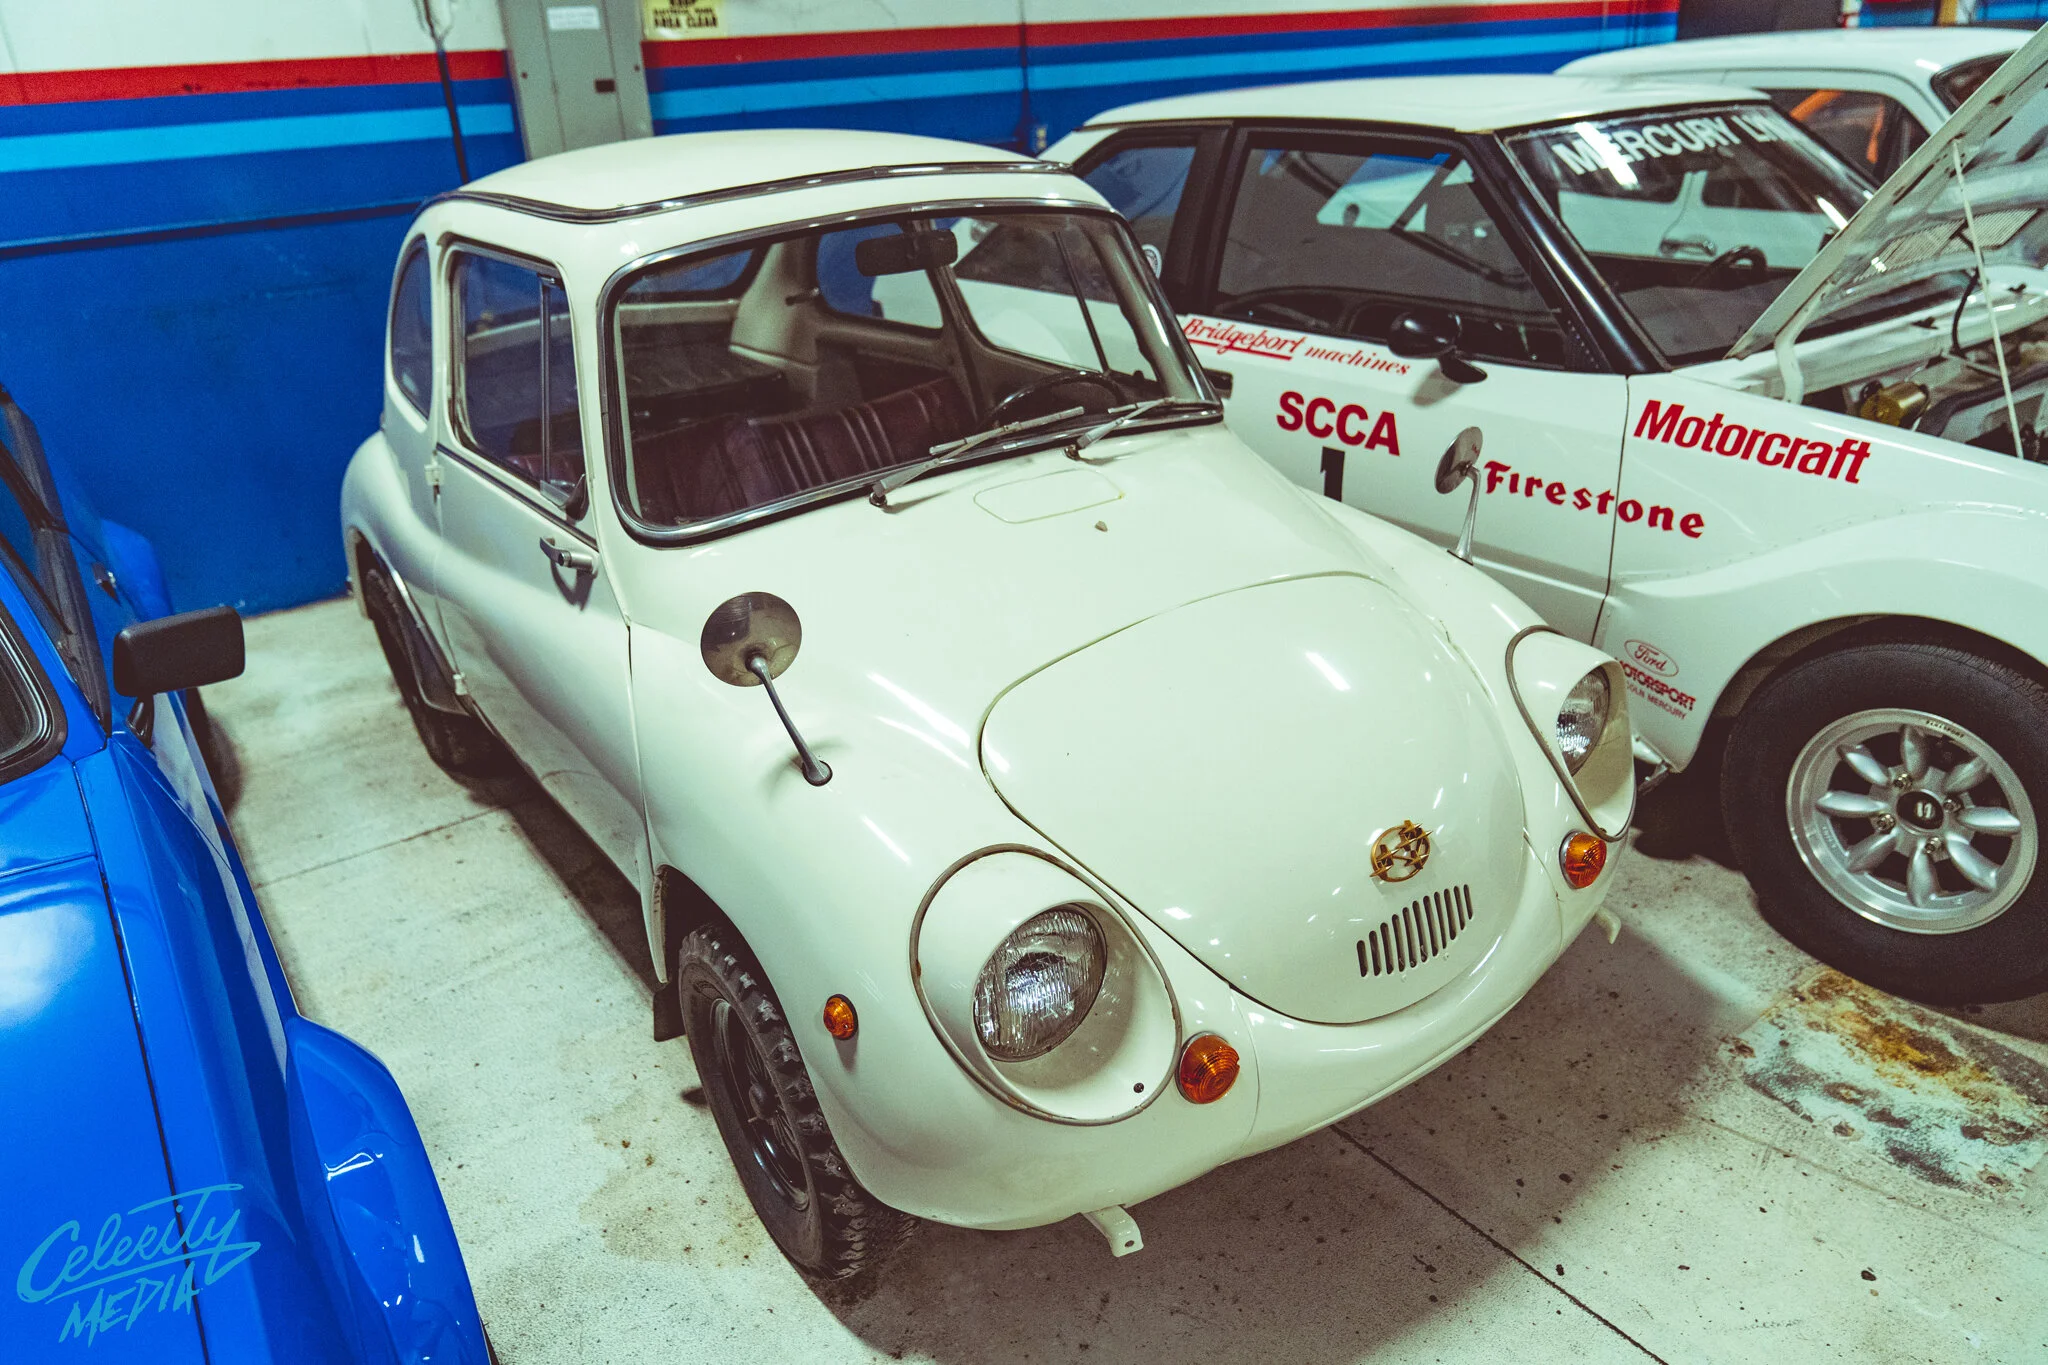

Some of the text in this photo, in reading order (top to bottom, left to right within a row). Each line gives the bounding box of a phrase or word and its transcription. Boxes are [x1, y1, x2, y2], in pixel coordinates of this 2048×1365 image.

[1552, 114, 1741, 176] MERCURY
[1181, 318, 1410, 376] Bridgeport machines
[1276, 391, 1400, 457] SCCA
[1634, 399, 1871, 484] Motorcraft
[1484, 461, 1706, 539] Firestone
[1634, 644, 1668, 672] Ford
